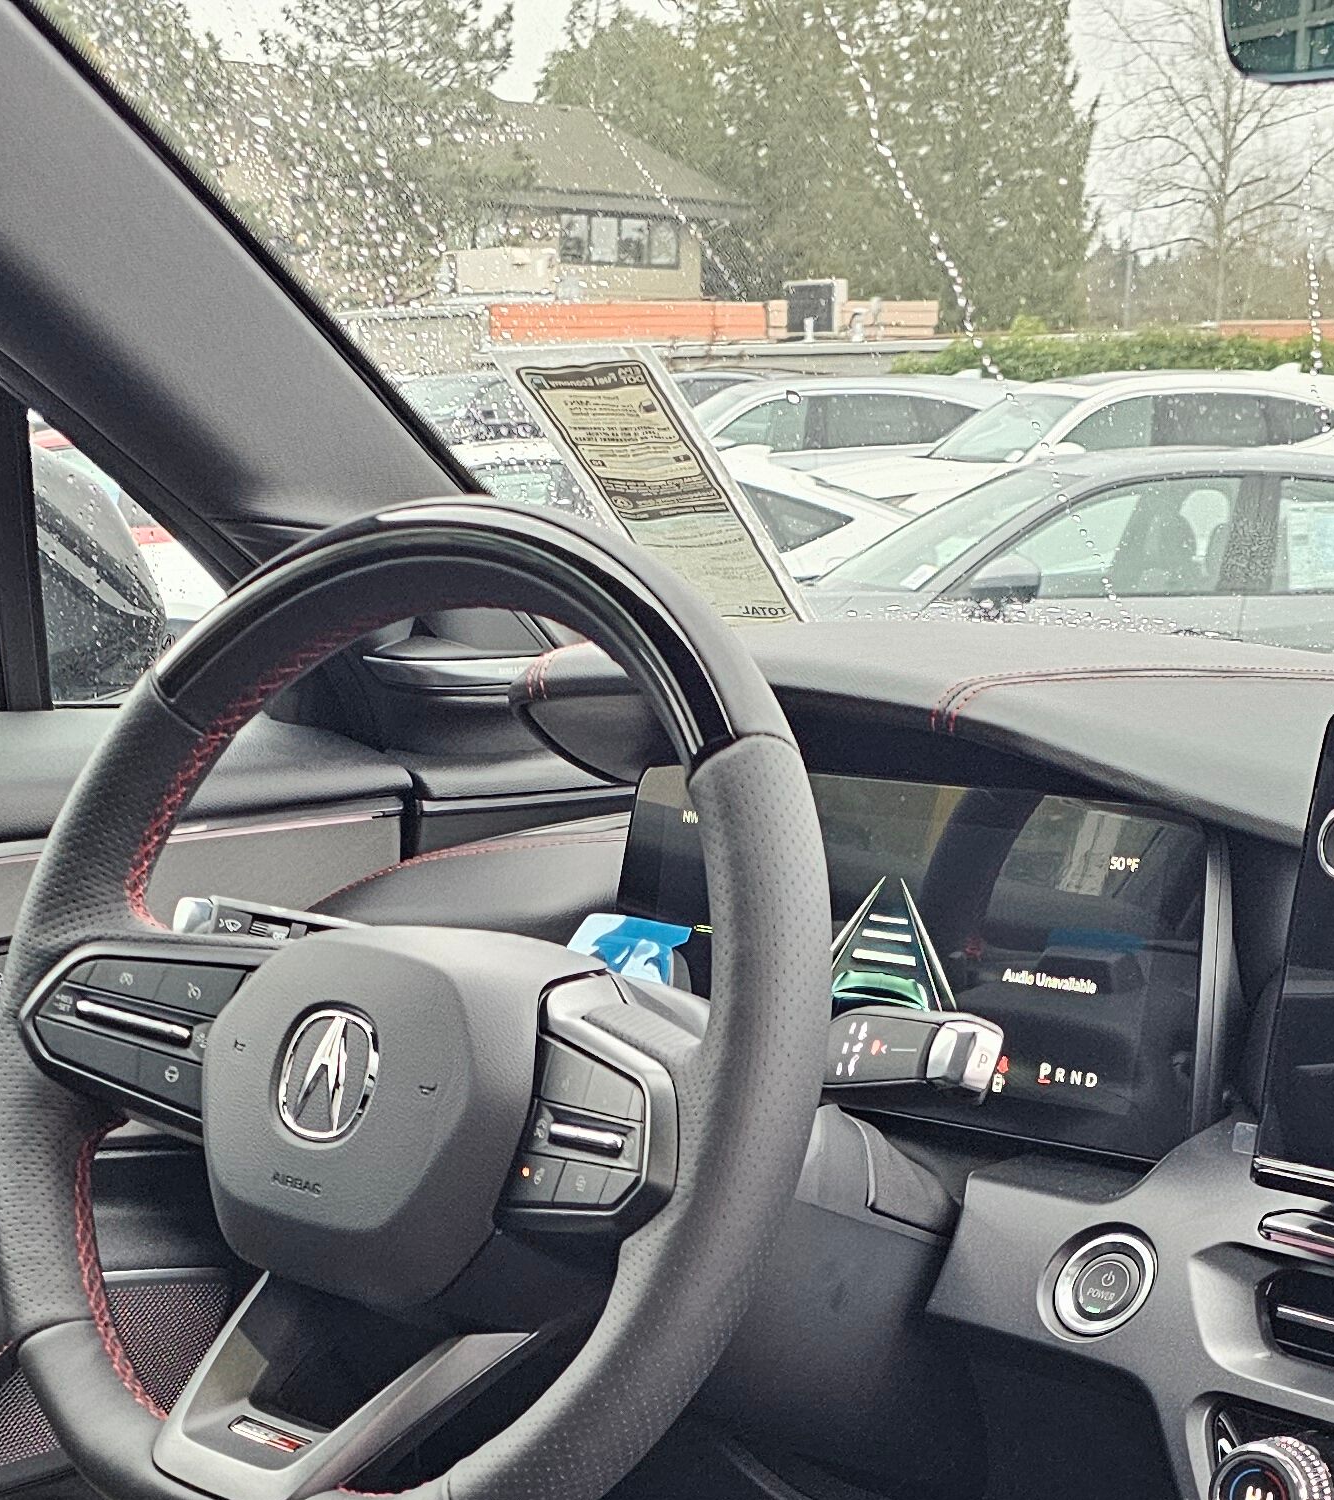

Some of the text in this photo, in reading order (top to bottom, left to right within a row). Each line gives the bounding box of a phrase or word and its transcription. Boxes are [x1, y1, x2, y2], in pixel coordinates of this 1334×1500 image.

[1109, 857, 1140, 873] 50°F
[1002, 968, 1098, 995] Audio Unavailable
[978, 1053, 988, 1068] P
[1039, 1062, 1098, 1088] P R N D
[1087, 1287, 1115, 1301] POWER
